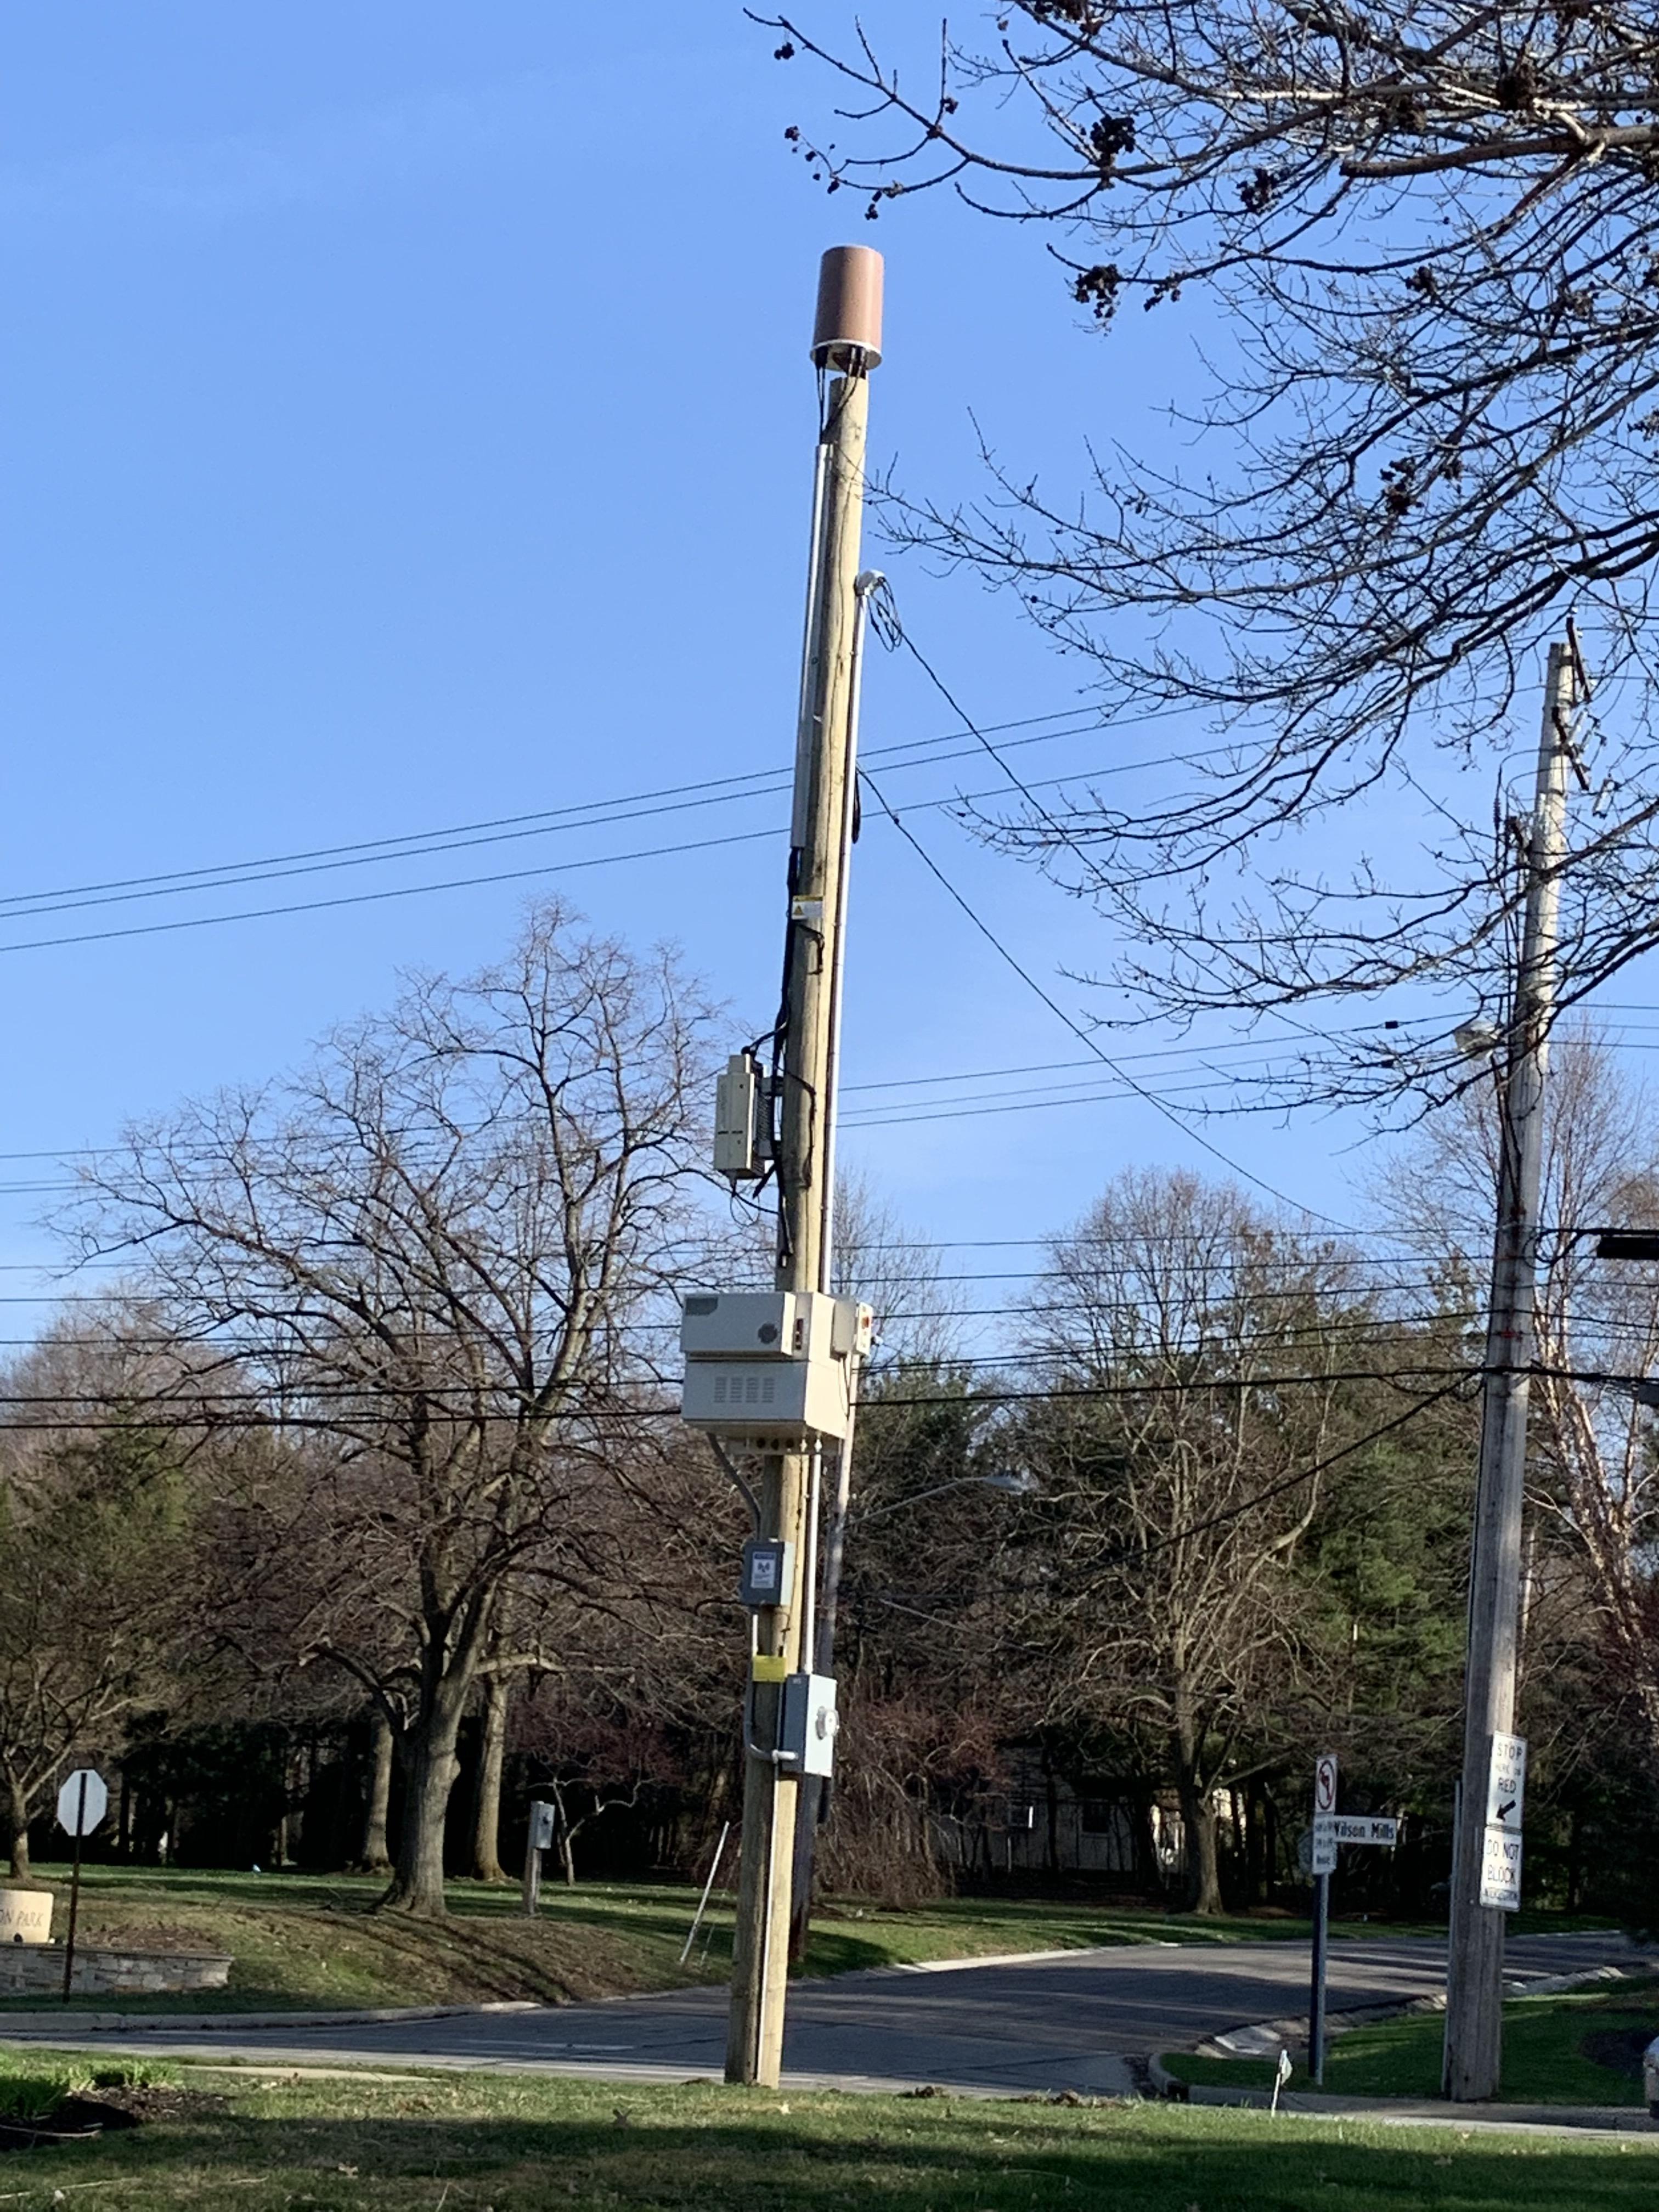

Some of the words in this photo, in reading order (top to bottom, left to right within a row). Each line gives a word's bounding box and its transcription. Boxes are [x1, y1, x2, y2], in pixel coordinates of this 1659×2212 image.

[1496, 1742, 1523, 1760] STOP
[1498, 1777, 1517, 1794] RED
[1372, 1822, 1394, 1839] Mills
[1486, 1838, 1499, 1857] DO
[1503, 1843, 1519, 1860] NOT
[1487, 1864, 1516, 1884] BLOCK
[16, 1910, 44, 1928] PARK
